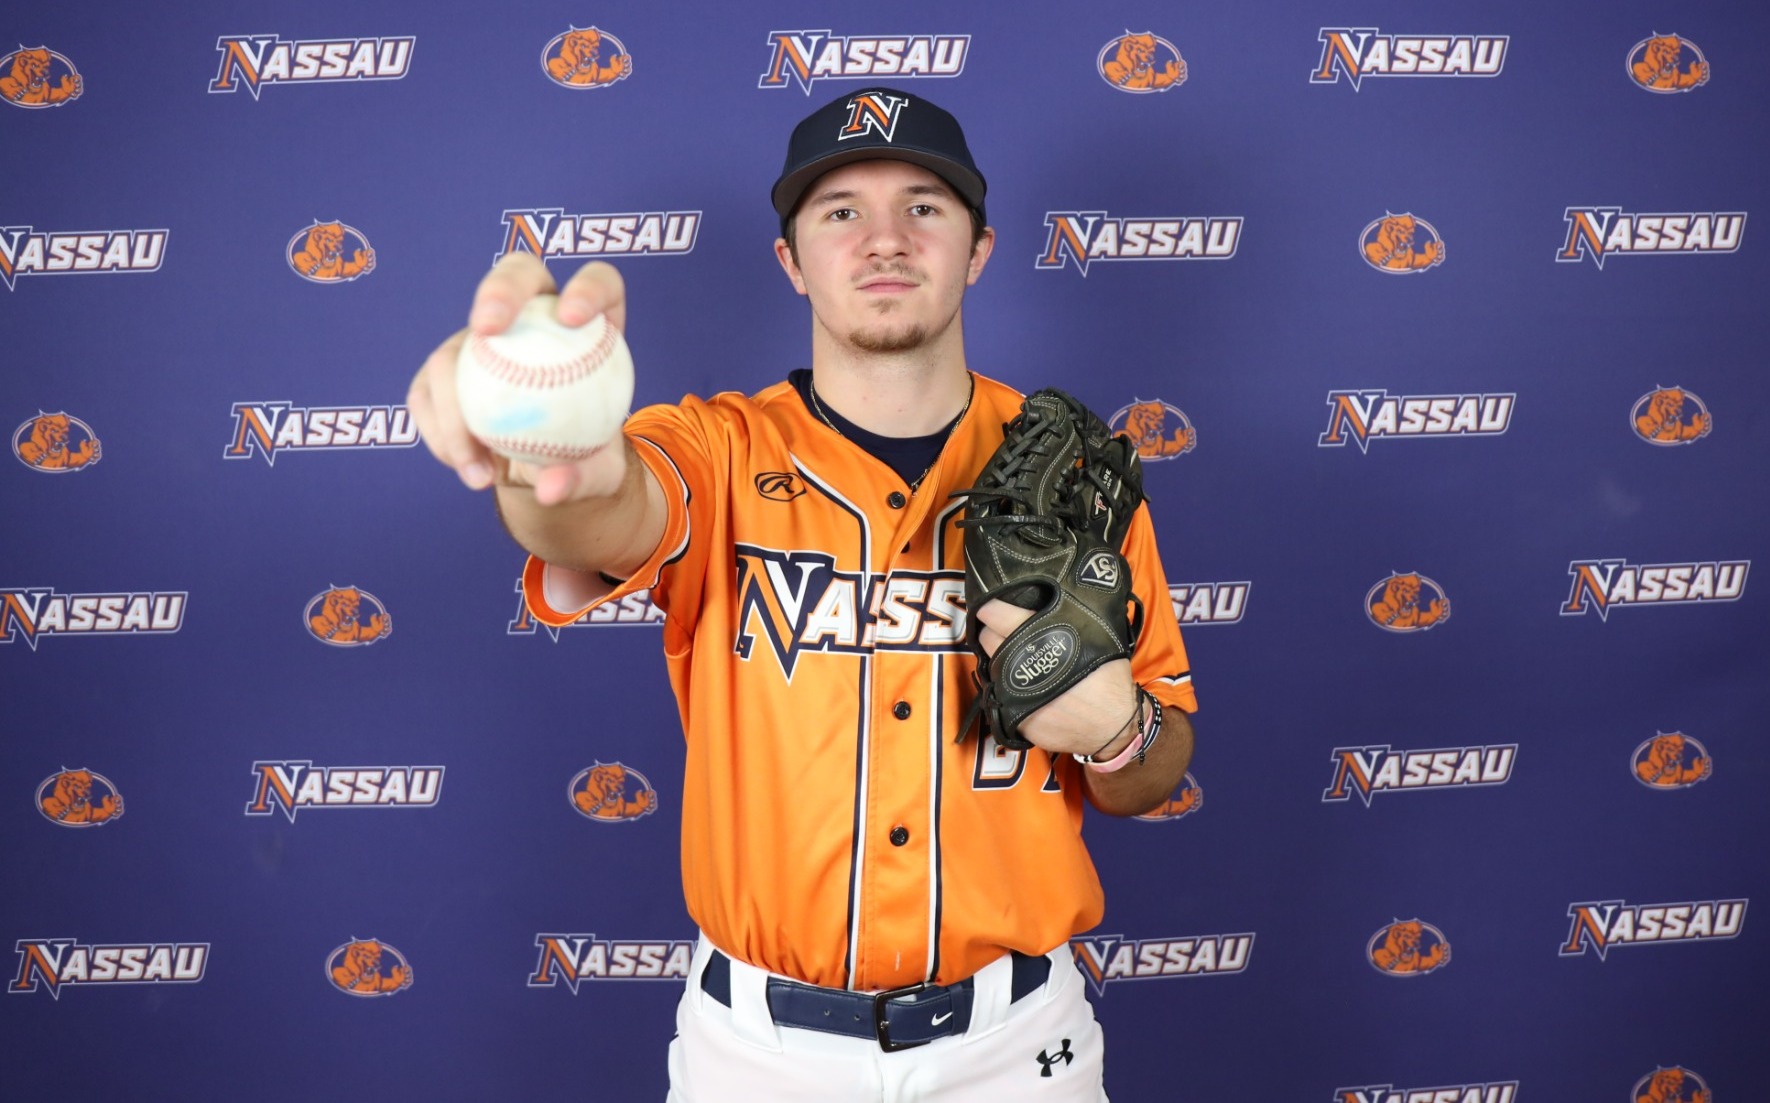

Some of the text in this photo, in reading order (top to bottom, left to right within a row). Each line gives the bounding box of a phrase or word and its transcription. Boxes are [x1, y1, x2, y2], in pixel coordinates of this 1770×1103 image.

[211, 36, 412, 96] NASSAU
[761, 31, 968, 91] NASSAU
[1313, 30, 1506, 88] NASSAU
[838, 91, 908, 142] N
[499, 210, 700, 260] NASSAU
[1038, 213, 1241, 273] NASSAU
[1559, 209, 1744, 266] NASSAU
[226, 403, 419, 463] NASSAU
[1321, 391, 1513, 451] NASSAU
[1563, 560, 1747, 617] NASSAU
[0, 589, 185, 648] NASSAU
[1014, 639, 1067, 686] Slugger
[248, 762, 442, 819] NASSAU
[1324, 746, 1515, 803] NASSAU
[1561, 900, 1745, 956] NASSAU
[11, 940, 207, 996] NASSAU
[1071, 934, 1253, 993] NASSAU
